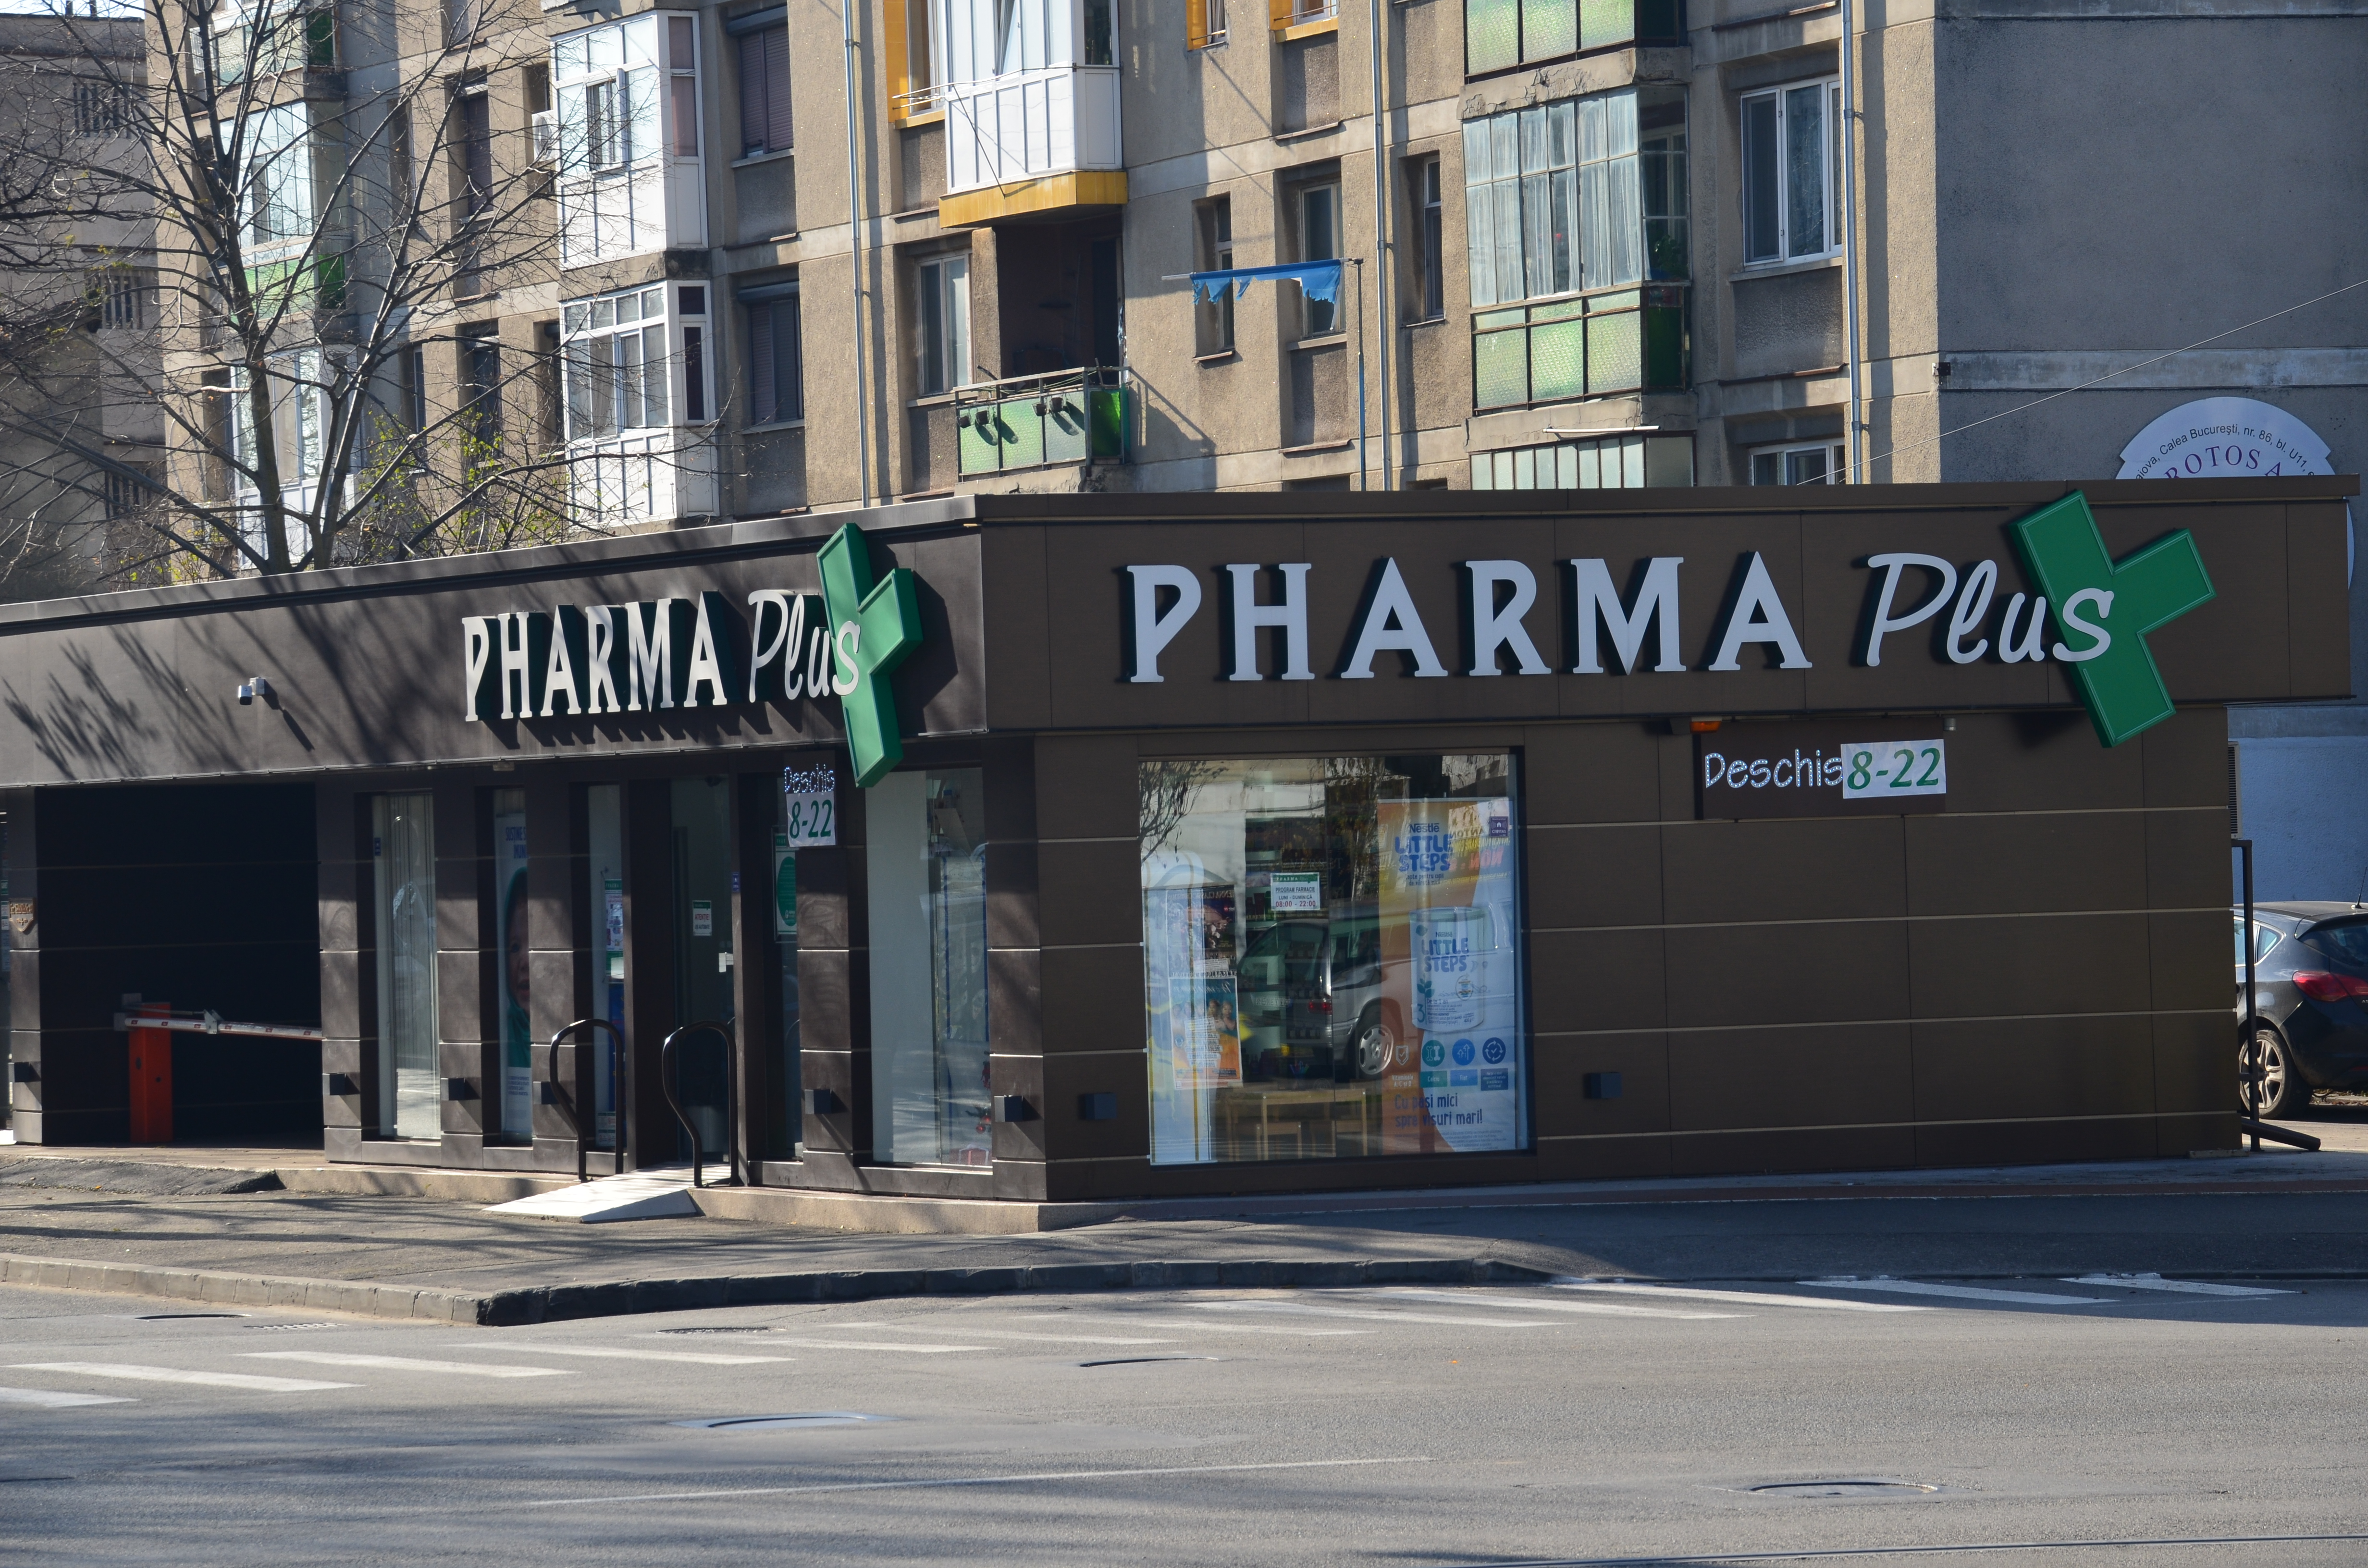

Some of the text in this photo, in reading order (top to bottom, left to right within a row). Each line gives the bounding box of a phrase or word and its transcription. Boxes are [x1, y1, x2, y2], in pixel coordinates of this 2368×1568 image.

[2159, 435, 2188, 455] Calea
[2244, 427, 2255, 437] nr.
[2259, 430, 2272, 446] 86,
[2276, 438, 2287, 453] bl.
[2289, 448, 2307, 472] U11,
[1127, 551, 2114, 683] PHARMA Plus
[461, 588, 861, 722] PHARMA Plus
[784, 763, 835, 793] Deschis
[1704, 747, 1941, 790] Deschis 8-22
[789, 799, 832, 839] 8-22
[1395, 833, 1454, 854] LITTLE
[1399, 853, 1450, 872] STEPS
[1421, 937, 1469, 956] LITTLE
[1424, 955, 1467, 972] STEPS
[1417, 1004, 1426, 1022] 3
[1395, 1093, 1408, 1110] Cu
[1437, 1092, 1458, 1108] mici
[1395, 1109, 1483, 1129] spre visuri mari!
